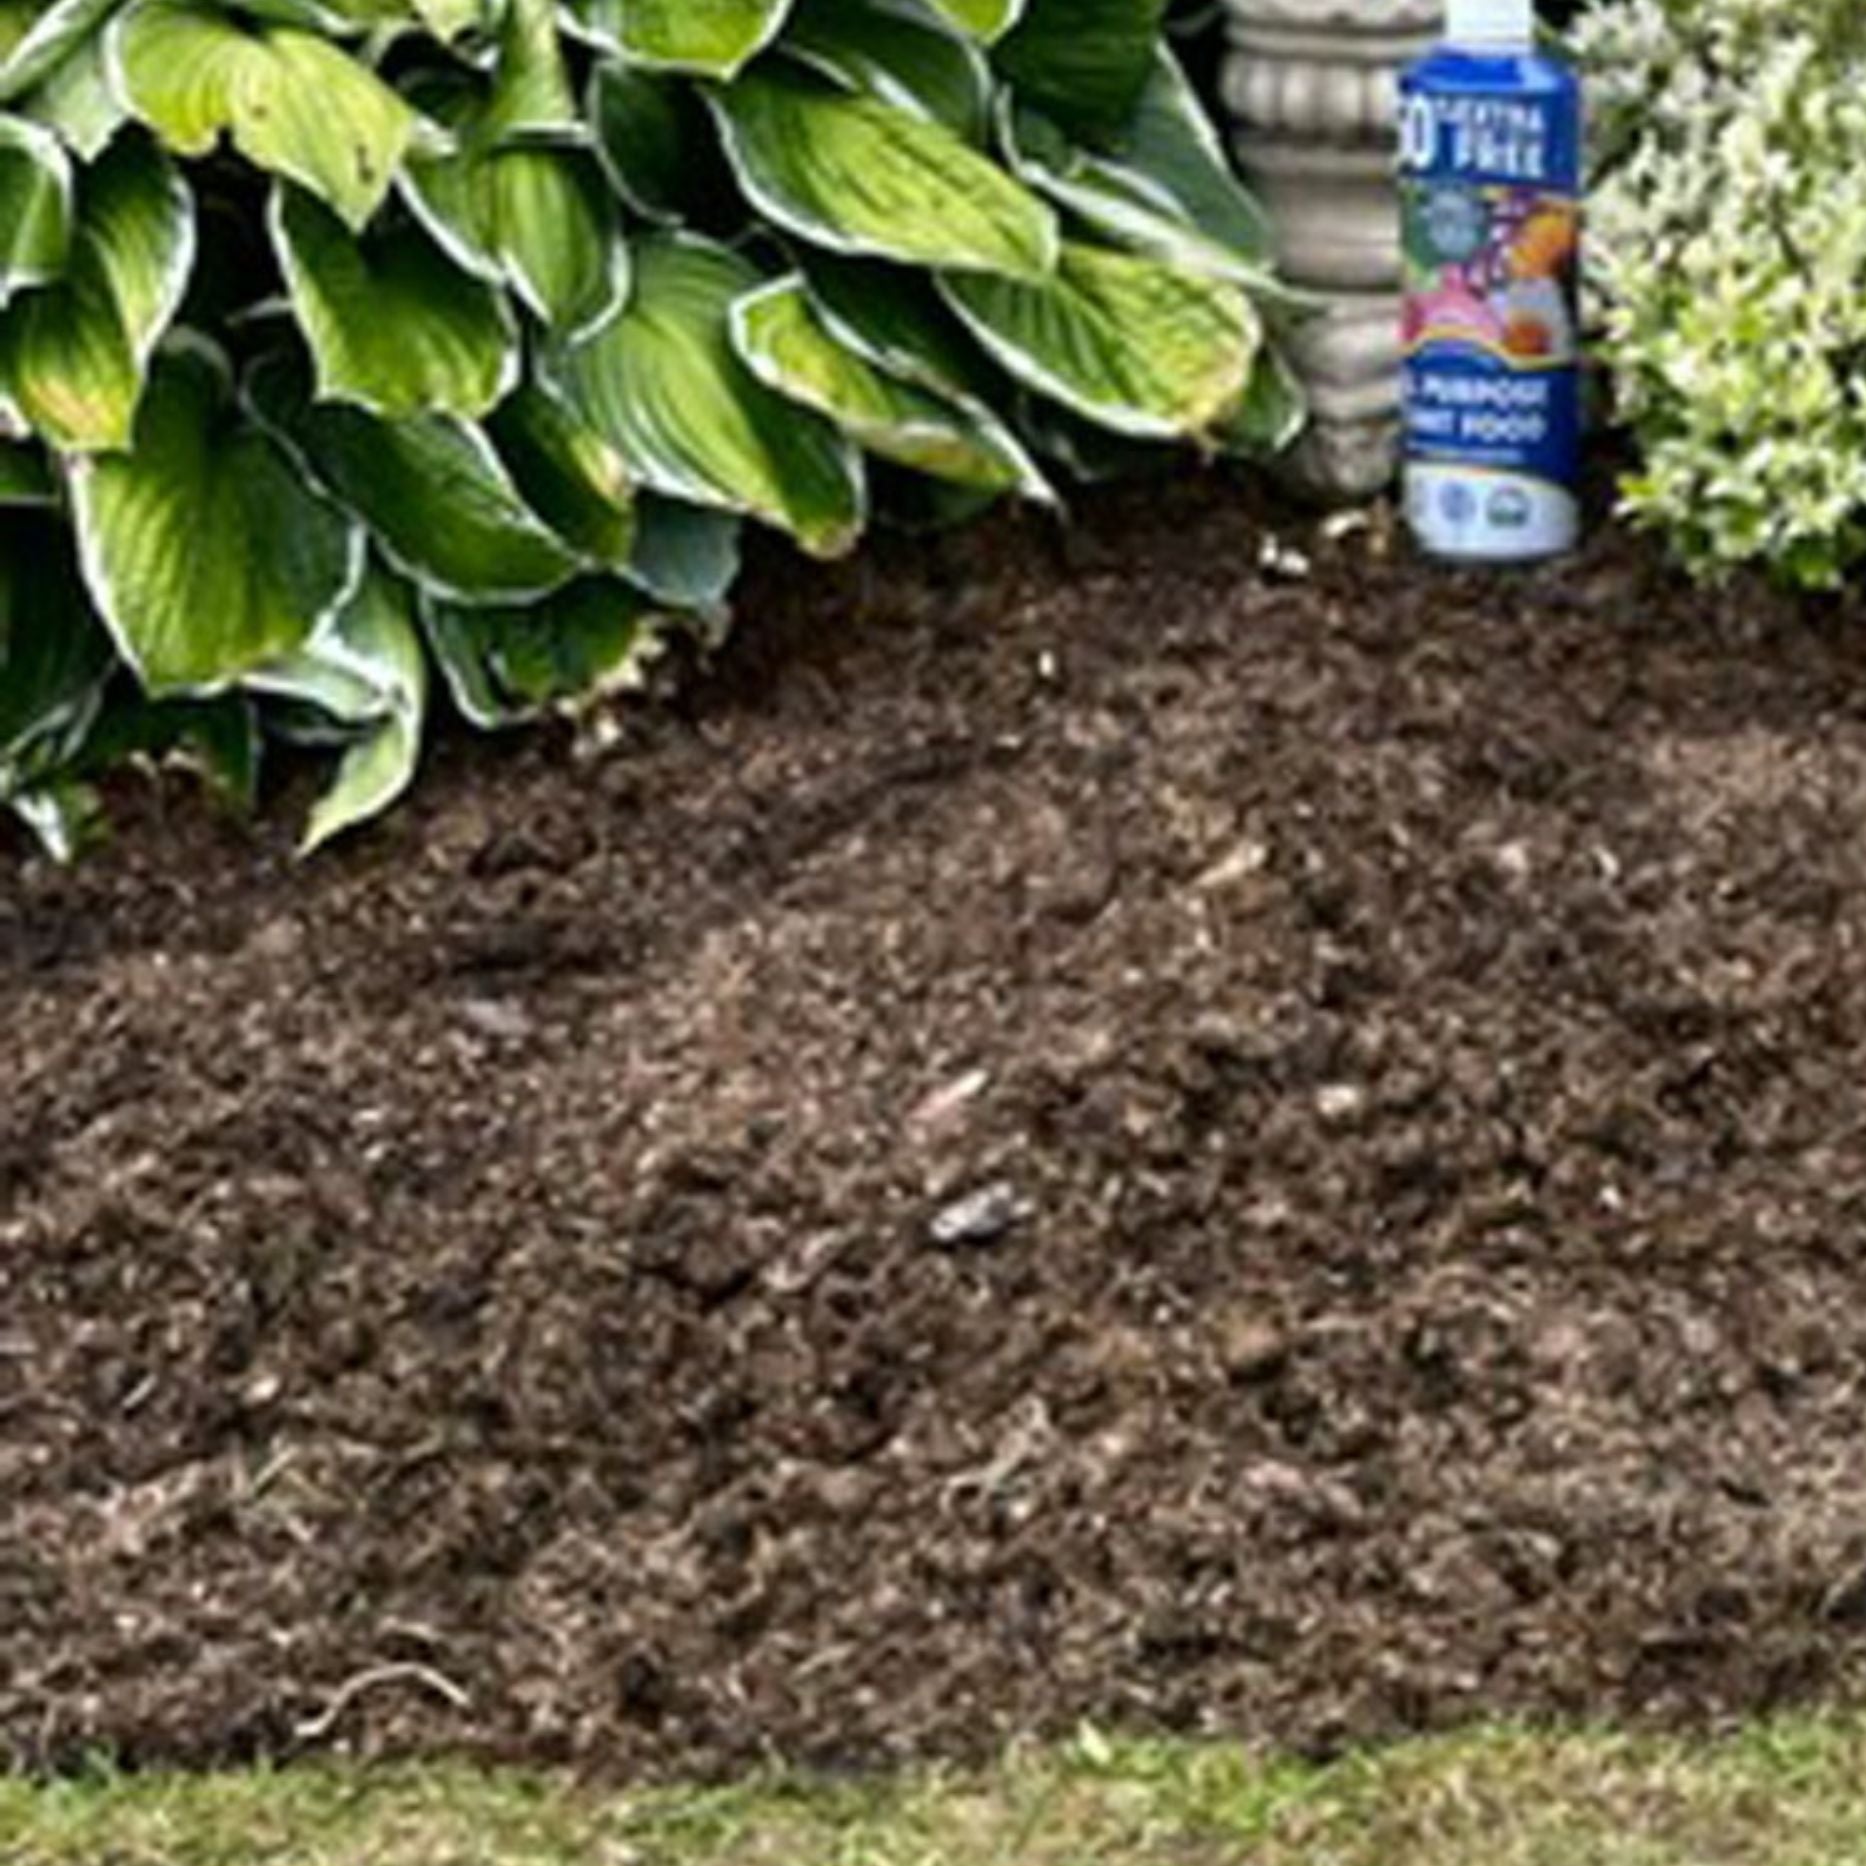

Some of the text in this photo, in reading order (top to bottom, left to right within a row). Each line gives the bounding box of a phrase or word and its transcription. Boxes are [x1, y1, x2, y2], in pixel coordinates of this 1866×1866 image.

[1452, 131, 1544, 177] FREE
[1423, 375, 1548, 407] PURPOSE
[1460, 412, 1547, 443] FOOD
